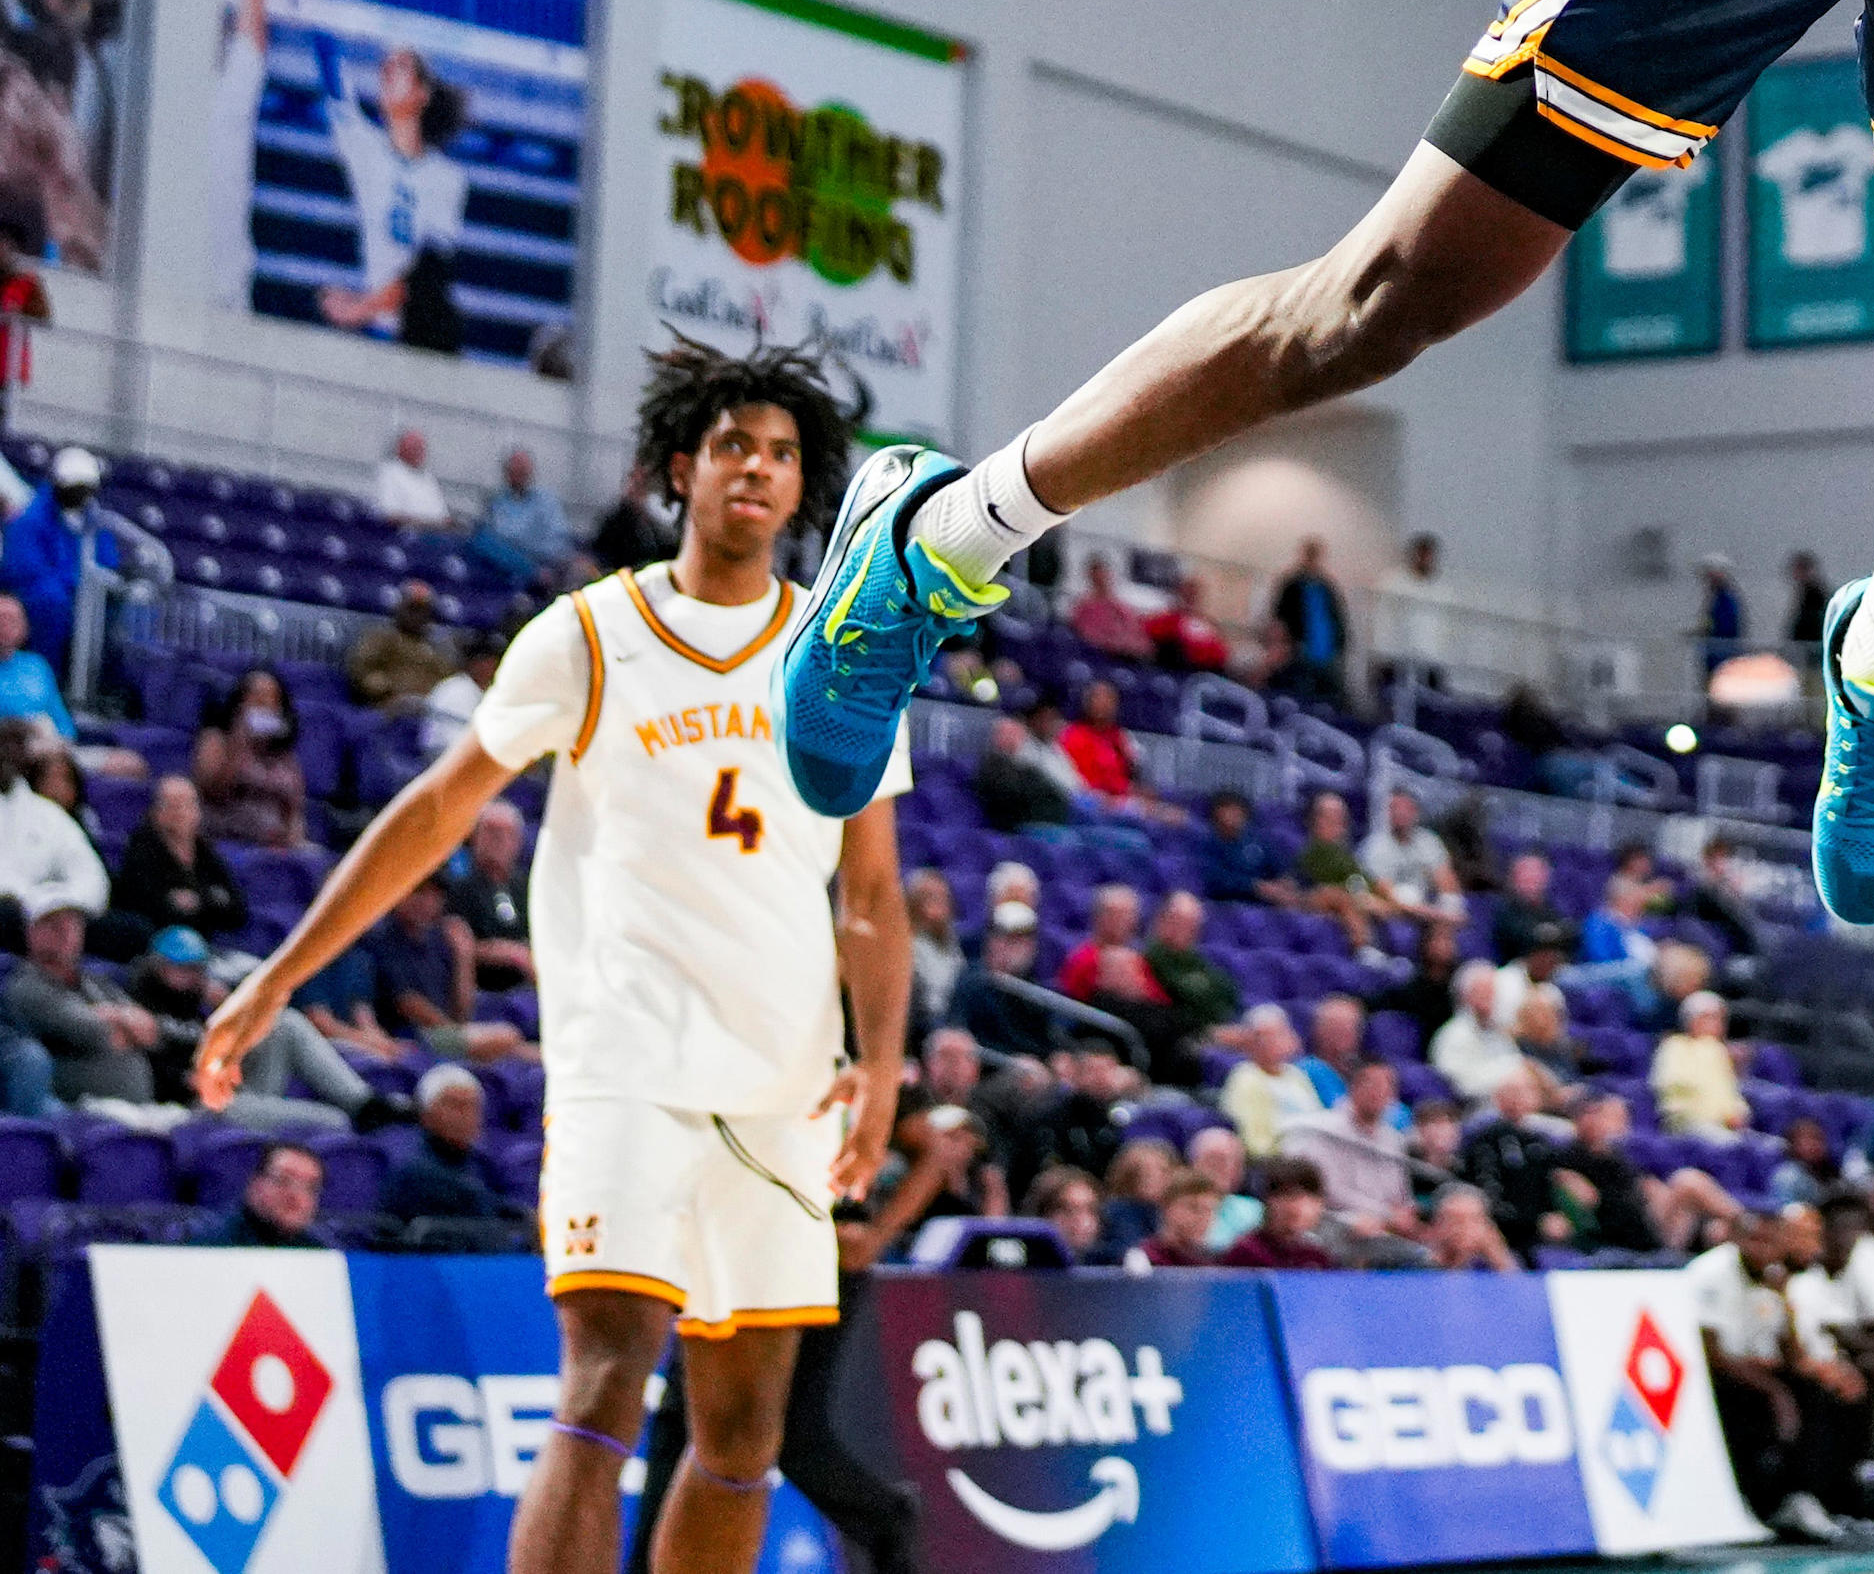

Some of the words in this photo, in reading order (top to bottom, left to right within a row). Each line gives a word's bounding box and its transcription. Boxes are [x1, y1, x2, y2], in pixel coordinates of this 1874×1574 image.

[634, 702, 774, 757] MUSTAN
[706, 766, 764, 855] 4
[911, 1310, 1184, 1449] alexa+
[1302, 1362, 1575, 1471] GEICO
